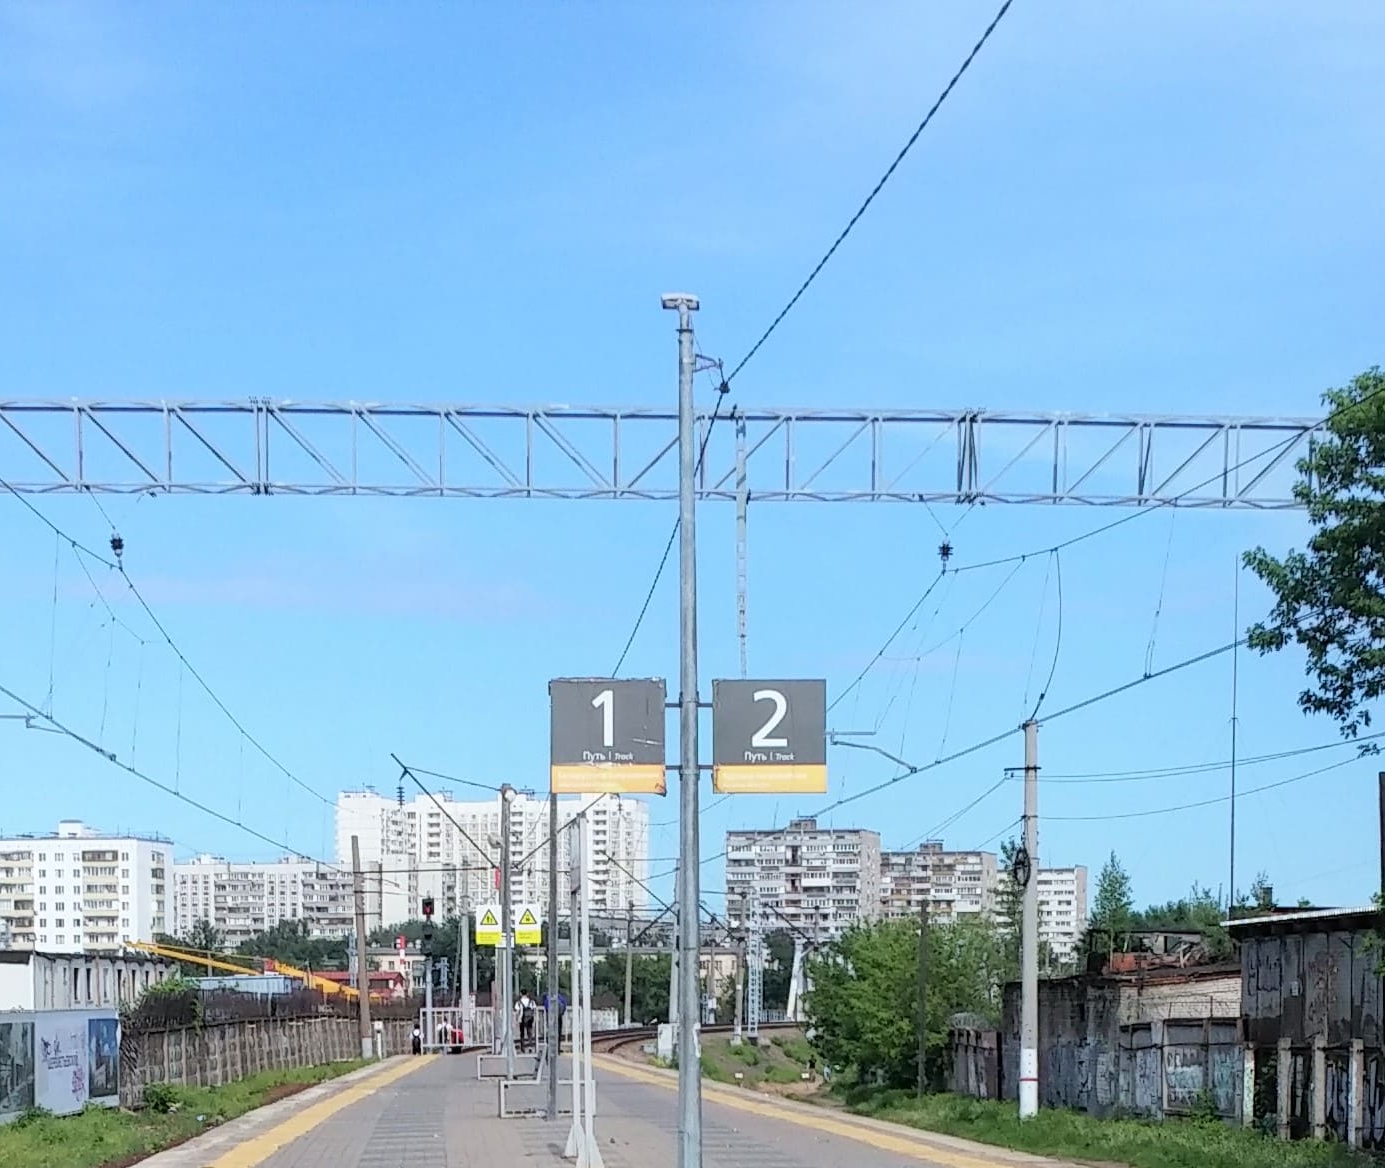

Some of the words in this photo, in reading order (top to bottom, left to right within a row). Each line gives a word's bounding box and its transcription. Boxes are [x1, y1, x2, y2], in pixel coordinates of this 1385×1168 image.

[591, 689, 614, 748] 1
[751, 689, 788, 748] 2
[582, 750, 606, 765] Путь
[744, 751, 767, 763] Путь
